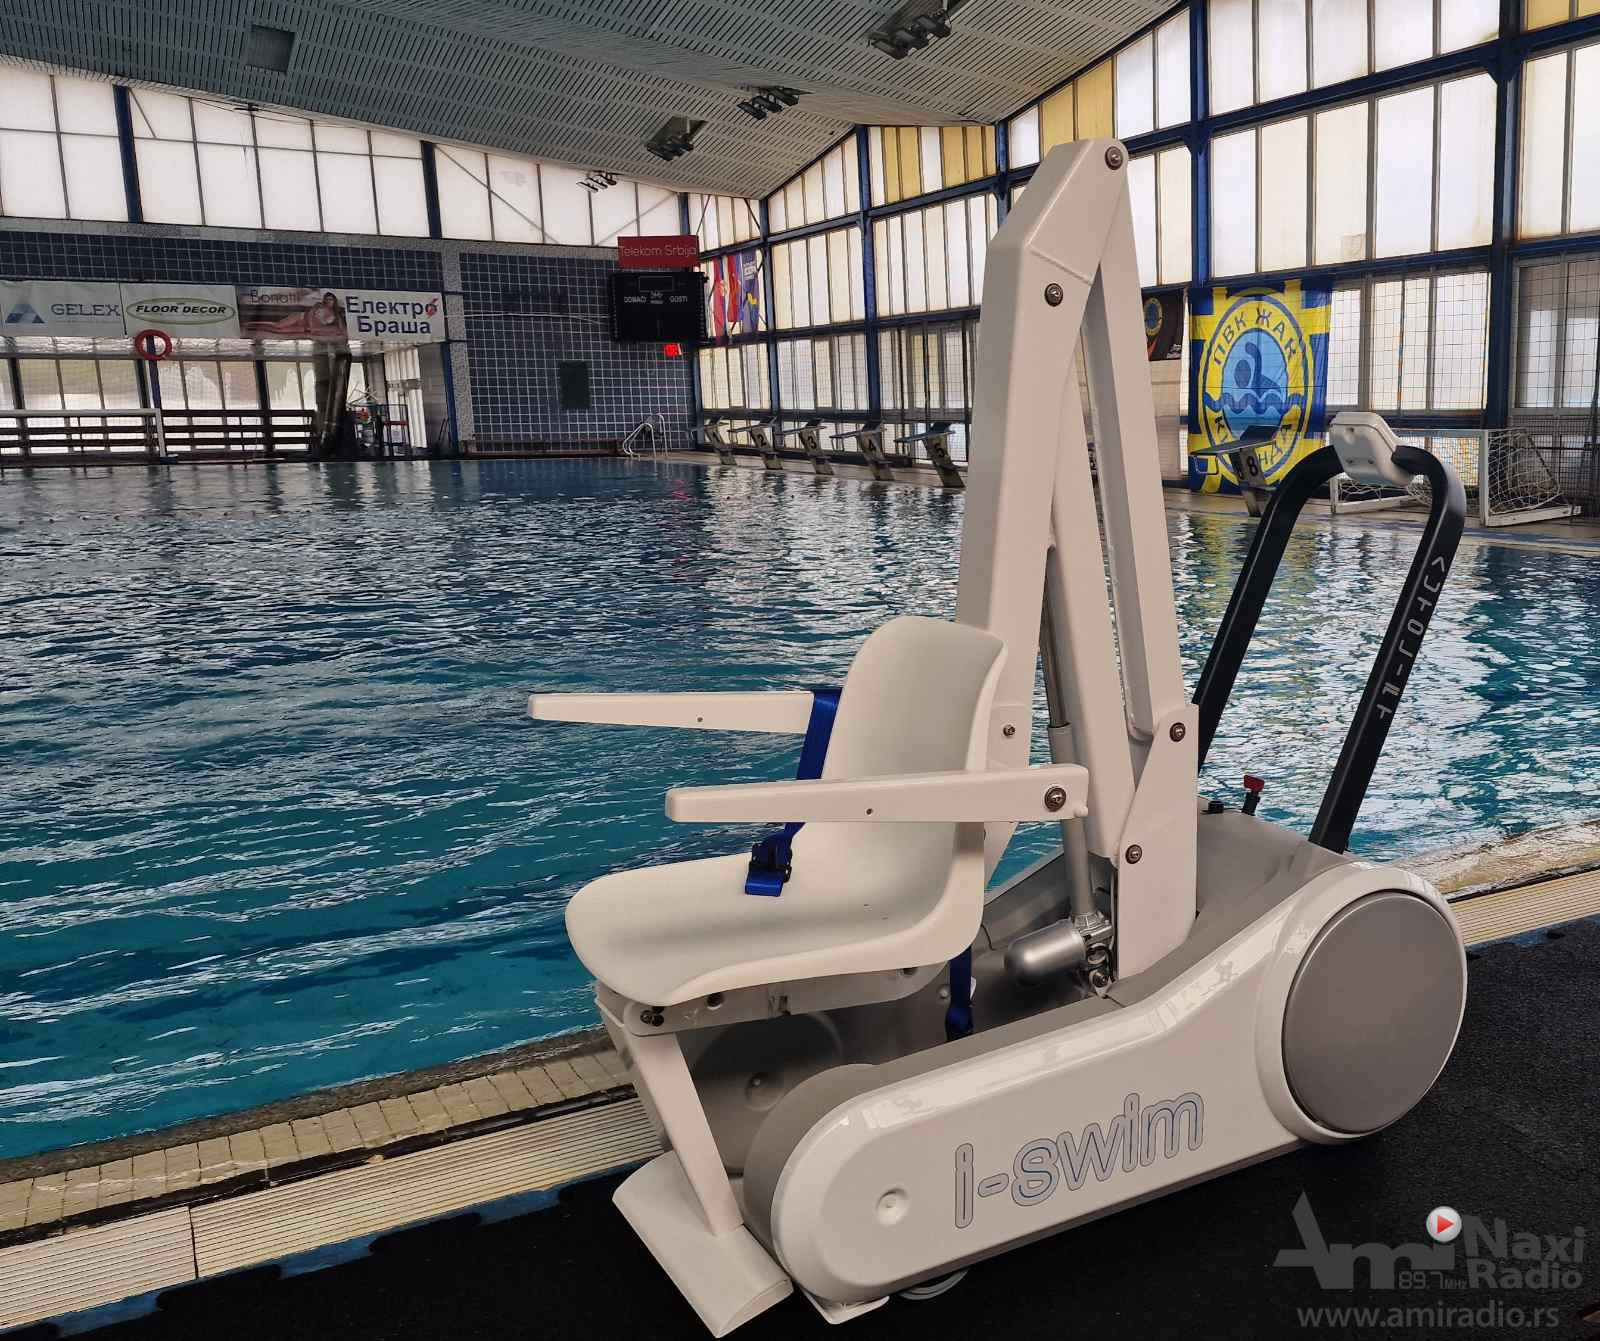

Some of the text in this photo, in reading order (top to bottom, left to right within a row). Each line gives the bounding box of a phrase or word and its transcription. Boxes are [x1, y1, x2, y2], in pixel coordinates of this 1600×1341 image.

[618, 244, 697, 258] Telekom Srbija
[50, 303, 121, 317] GELEX
[135, 304, 227, 315] FLOOR DECOR
[345, 296, 438, 319] Електро
[356, 315, 431, 337] Браша
[807, 435, 817, 449] 3
[1246, 455, 1258, 477] 8
